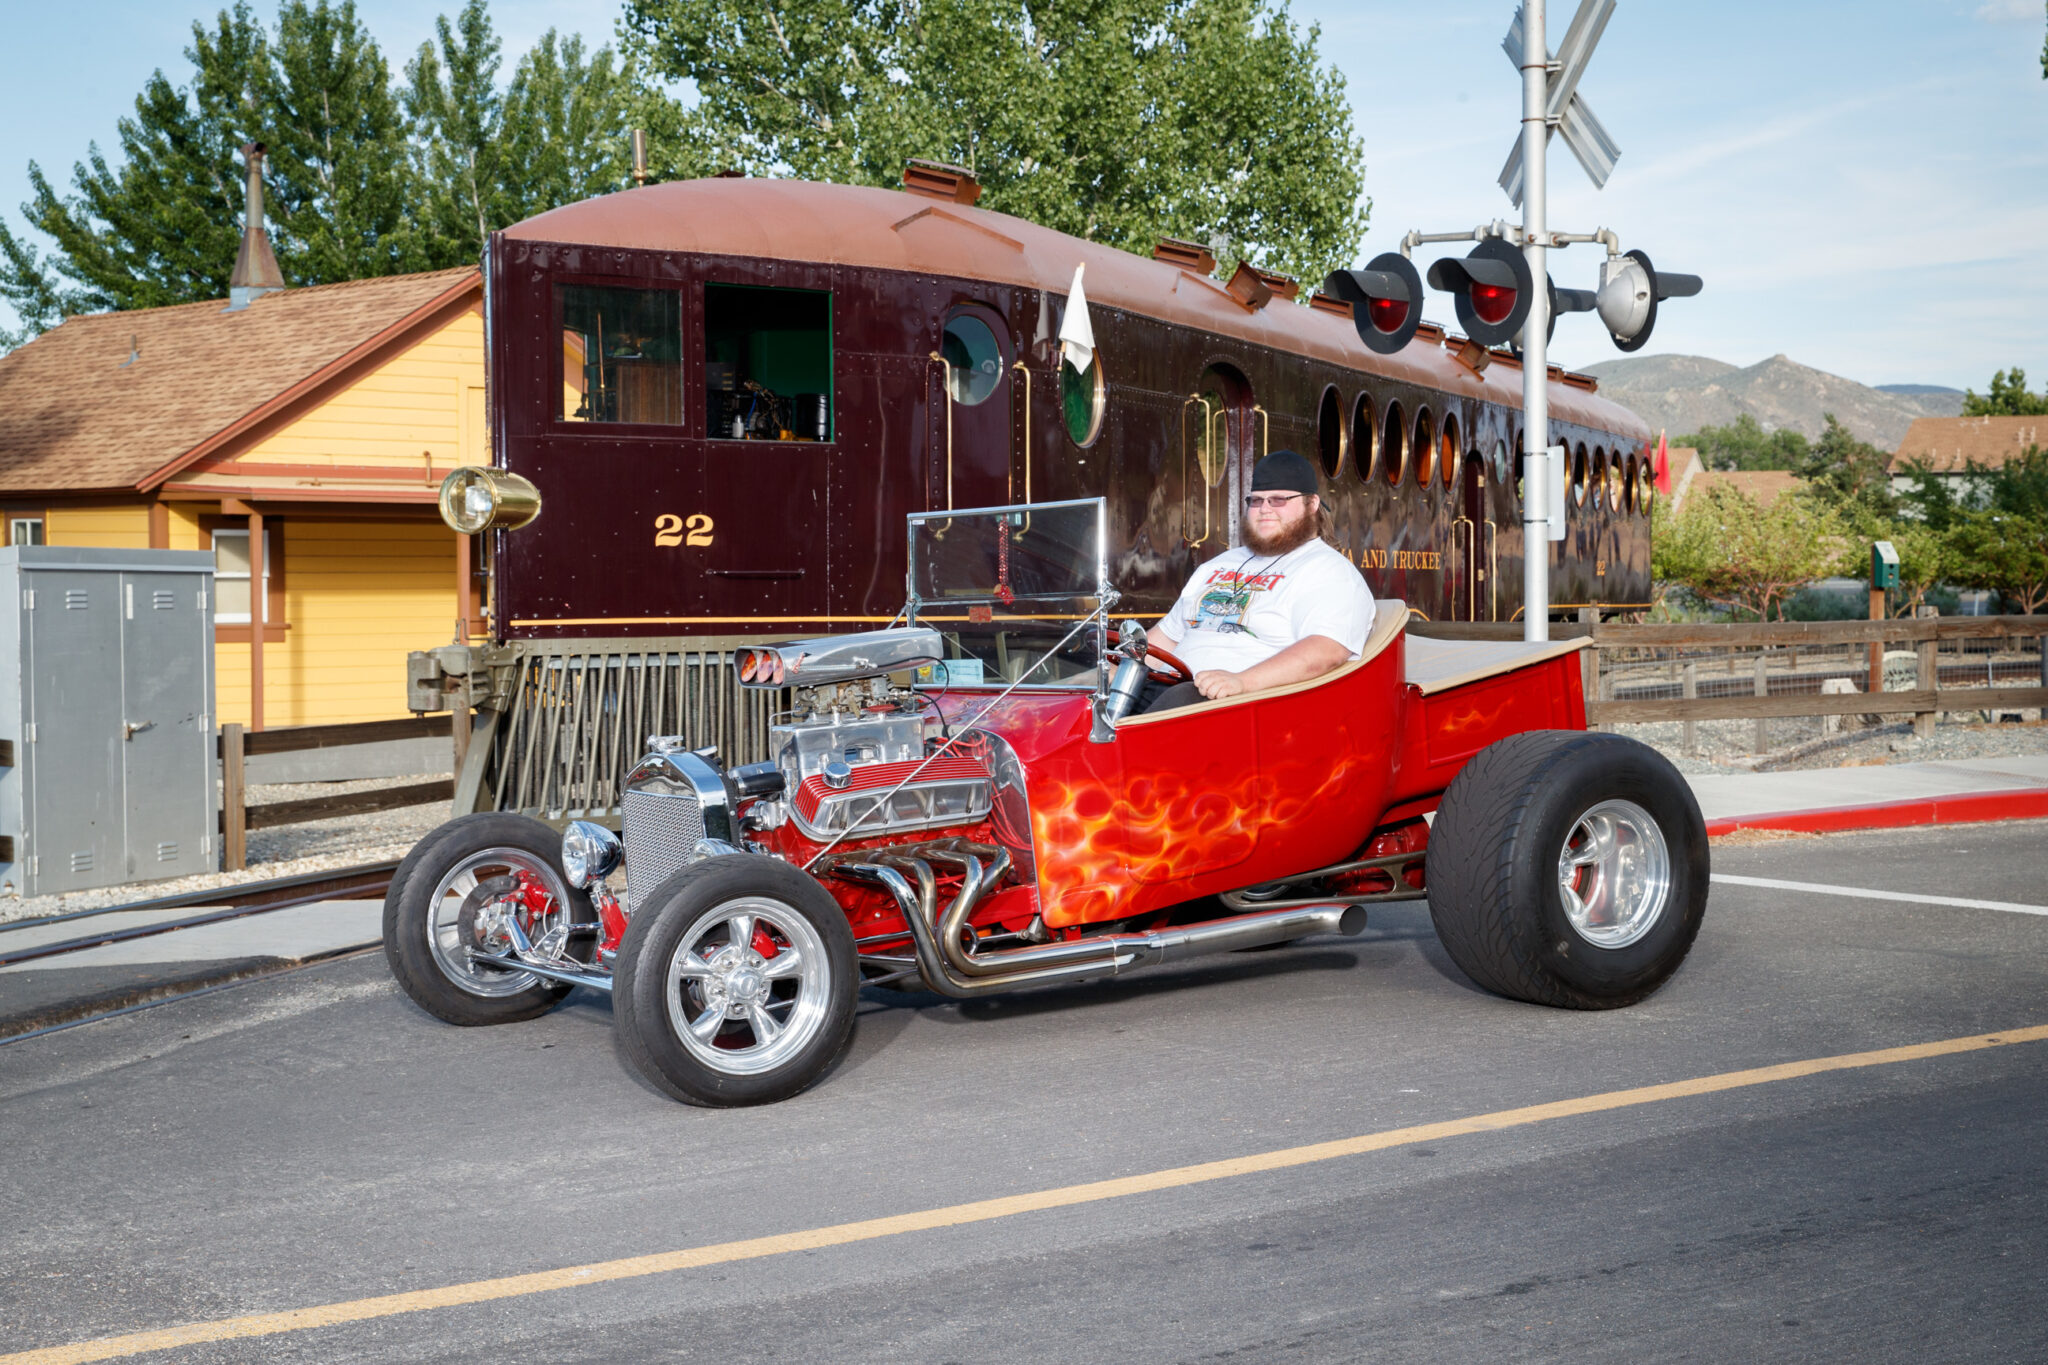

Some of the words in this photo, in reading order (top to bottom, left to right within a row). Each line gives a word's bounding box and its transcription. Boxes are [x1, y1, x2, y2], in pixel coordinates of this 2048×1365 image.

[654, 513, 714, 547] 22
[1360, 549, 1387, 569] AND
[1392, 550, 1441, 570] TRUCKEE
